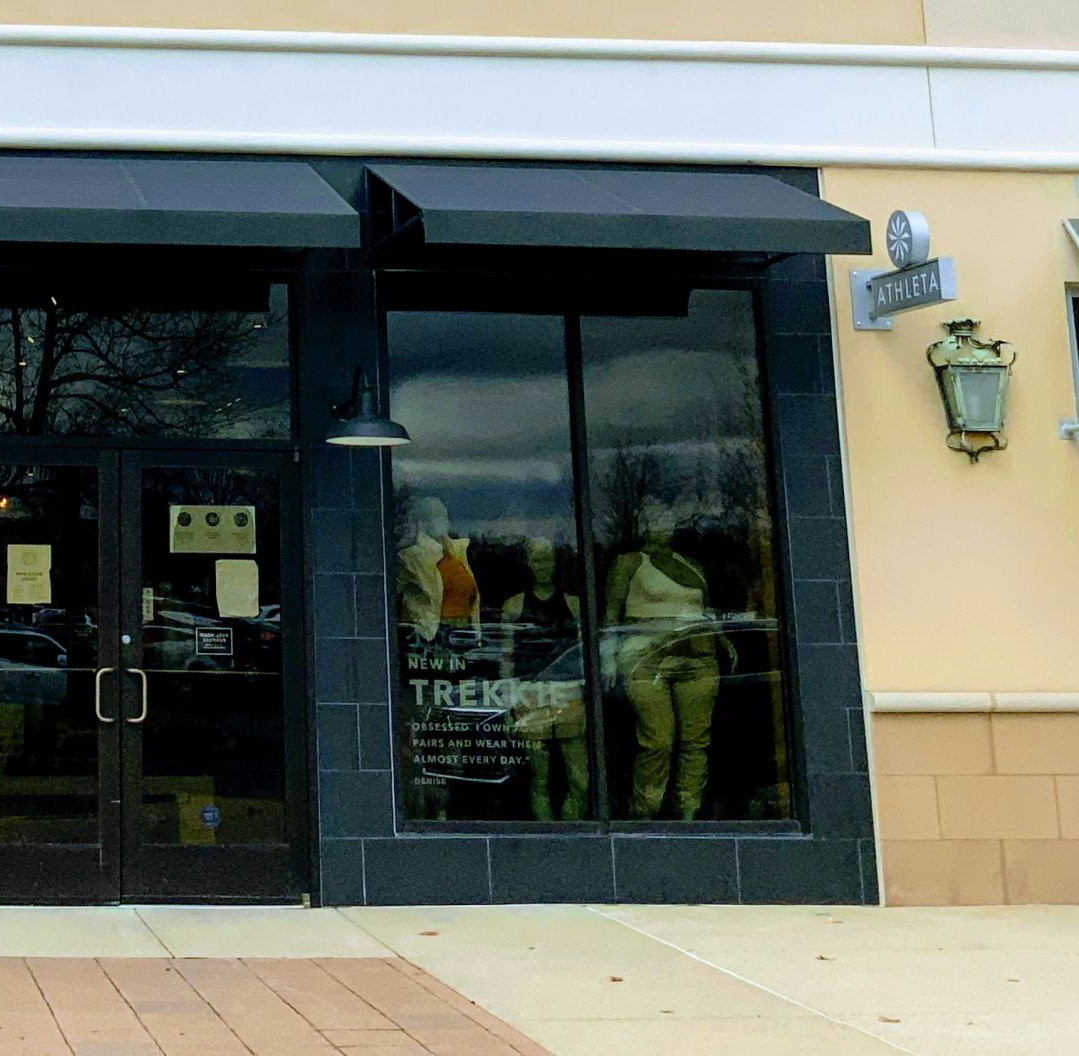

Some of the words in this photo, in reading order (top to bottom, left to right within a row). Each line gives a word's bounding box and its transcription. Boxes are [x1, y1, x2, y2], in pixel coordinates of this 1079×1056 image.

[877, 270, 939, 306] ATHLETA
[408, 655, 443, 670] NEW
[449, 657, 466, 671] IN
[482, 722, 511, 733] OWN
[413, 738, 444, 749] PAIRS
[448, 738, 472, 749] AND
[476, 739, 507, 749] WEAR
[511, 739, 542, 750] THEM
[413, 754, 459, 765] ALMOST
[462, 755, 497, 765] EVERY
